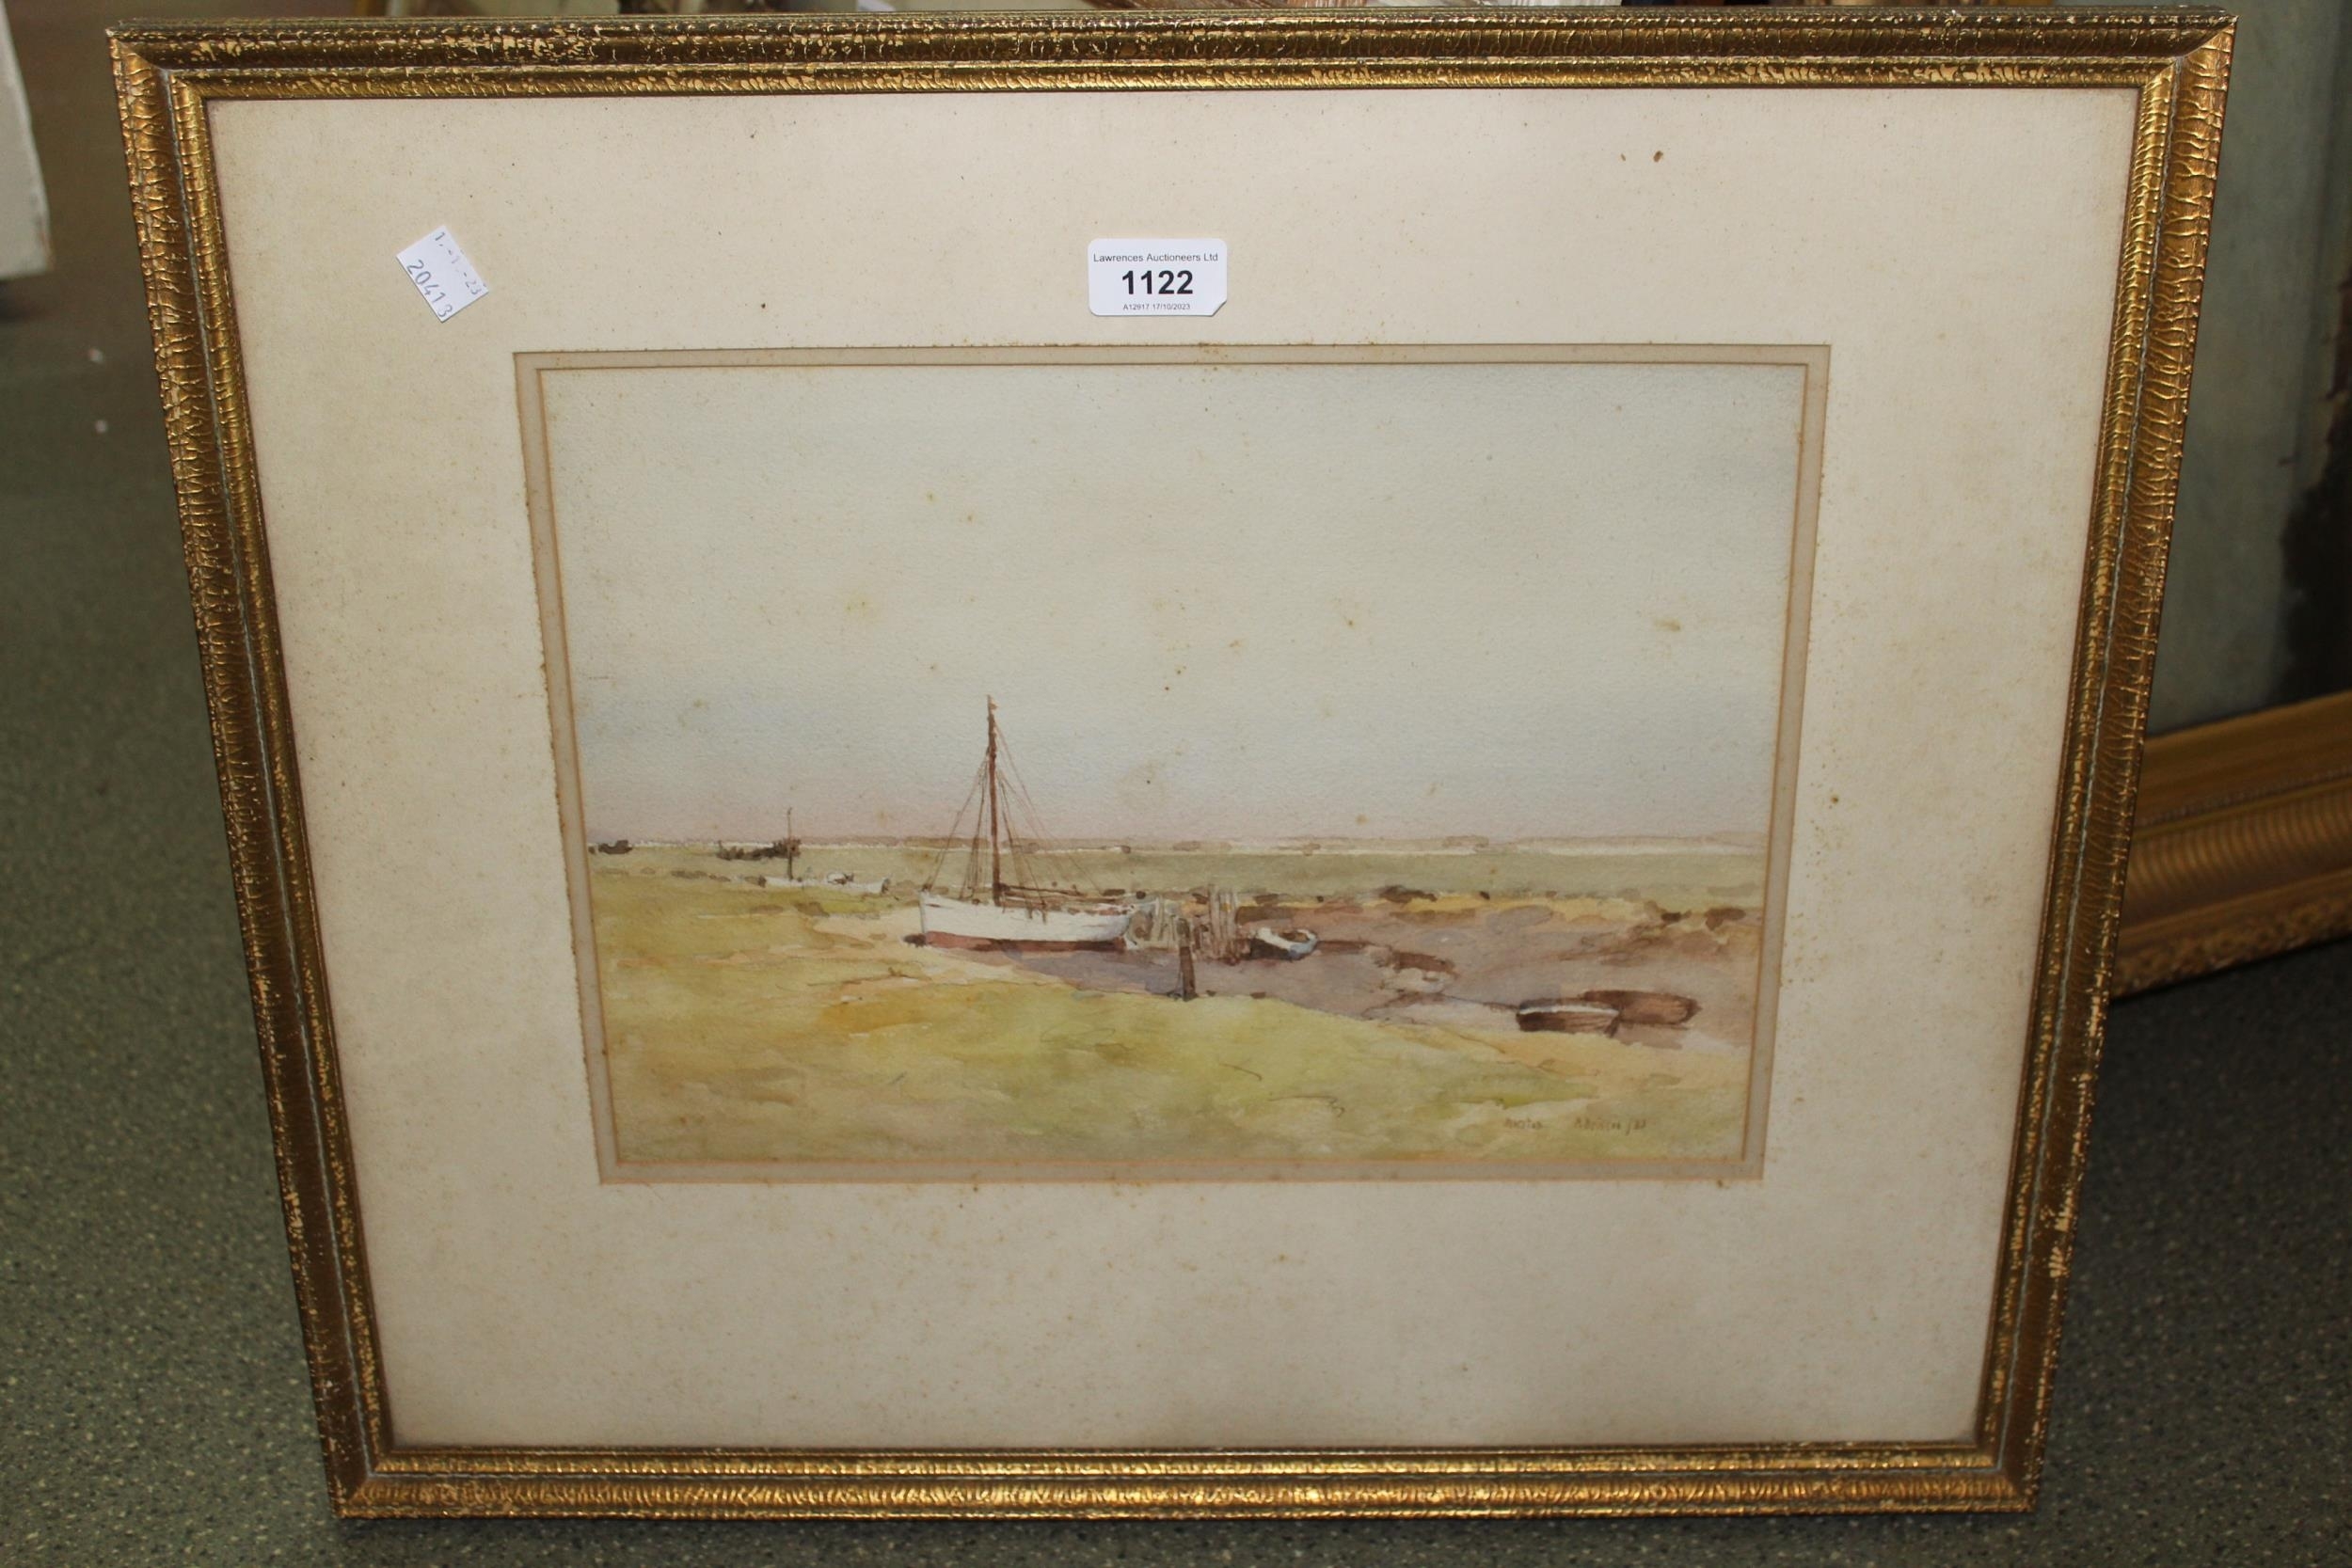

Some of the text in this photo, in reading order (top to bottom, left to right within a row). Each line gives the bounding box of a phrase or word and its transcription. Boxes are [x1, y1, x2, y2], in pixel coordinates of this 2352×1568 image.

[1093, 253, 1218, 262] Lawrences Auctioneers Ltd
[406, 259, 453, 318] 20413
[1121, 270, 1194, 294] 1122
